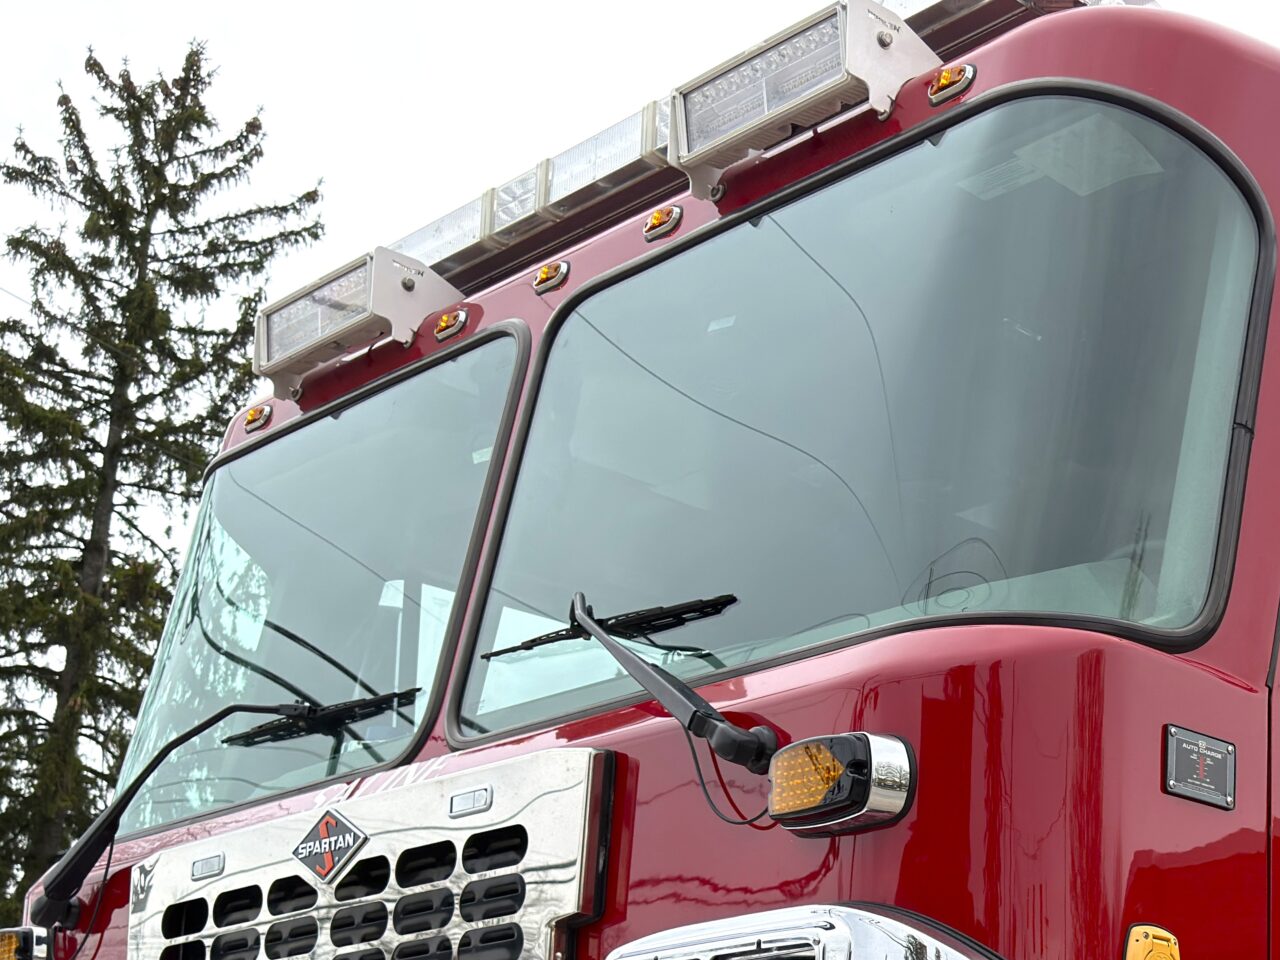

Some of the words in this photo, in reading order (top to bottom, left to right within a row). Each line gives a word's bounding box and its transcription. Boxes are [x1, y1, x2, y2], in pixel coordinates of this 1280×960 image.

[1182, 742, 1199, 752] AUTO
[1199, 748, 1223, 760] CHARGE
[298, 832, 354, 858] SPARTAN
